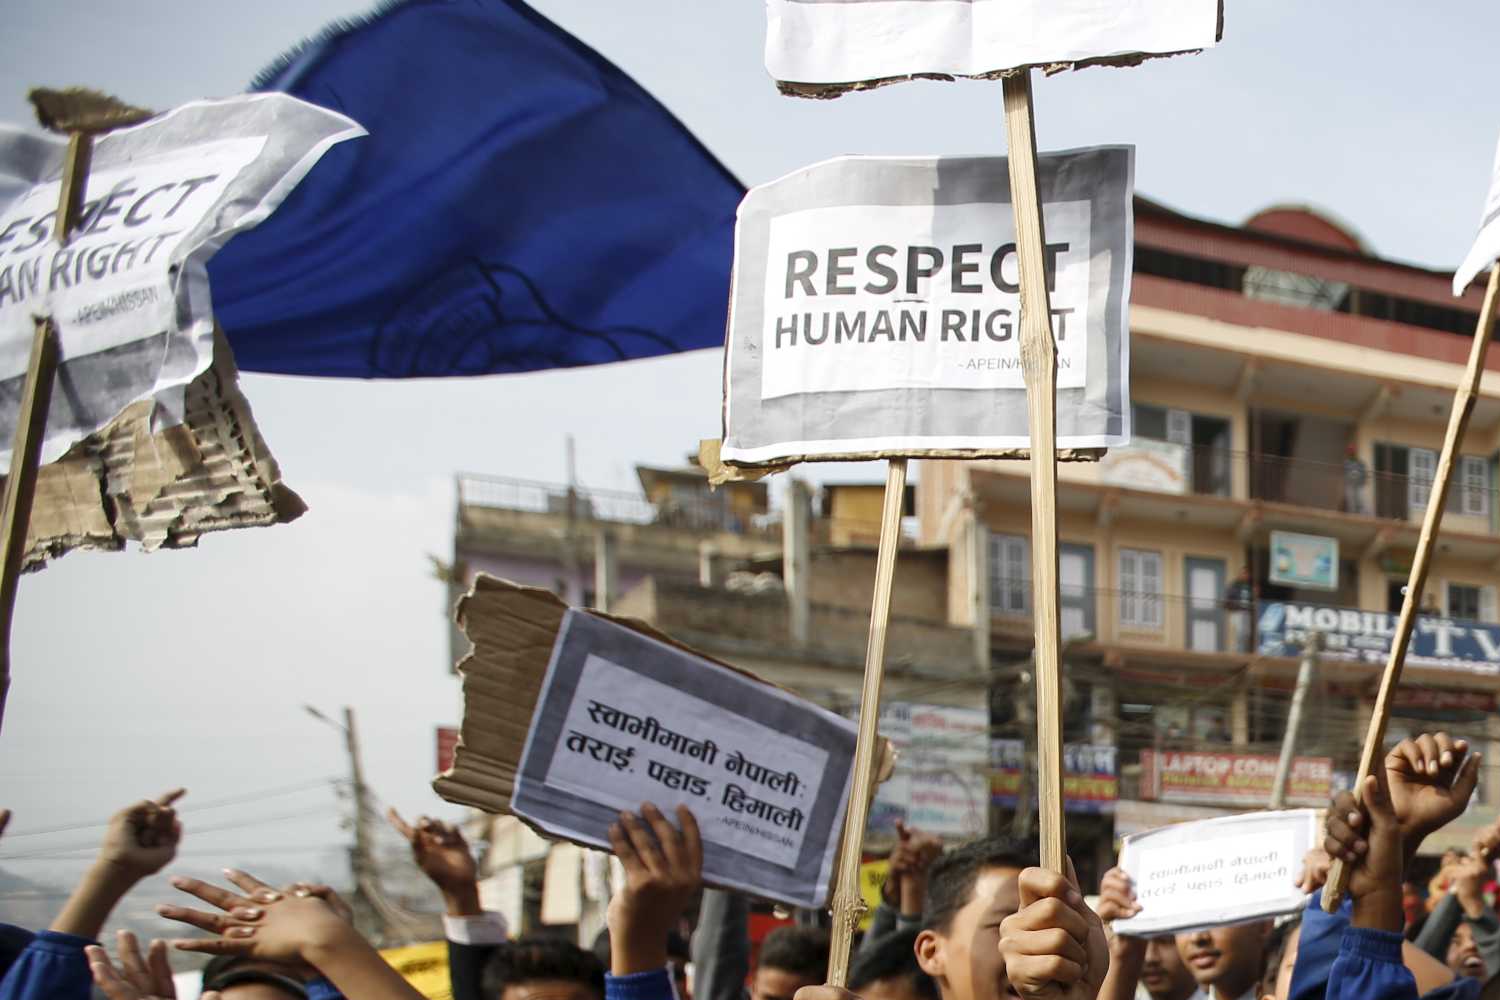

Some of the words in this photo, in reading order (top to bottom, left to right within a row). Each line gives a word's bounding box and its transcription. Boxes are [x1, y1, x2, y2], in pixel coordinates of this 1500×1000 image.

[49, 229, 184, 291] RIGHT
[784, 242, 1070, 299] RESPECT
[775, 309, 928, 348] HUMAN
[940, 307, 1076, 343] RIGT
[1285, 604, 1400, 636] MOBIL
[721, 783, 804, 832] हिमाली
